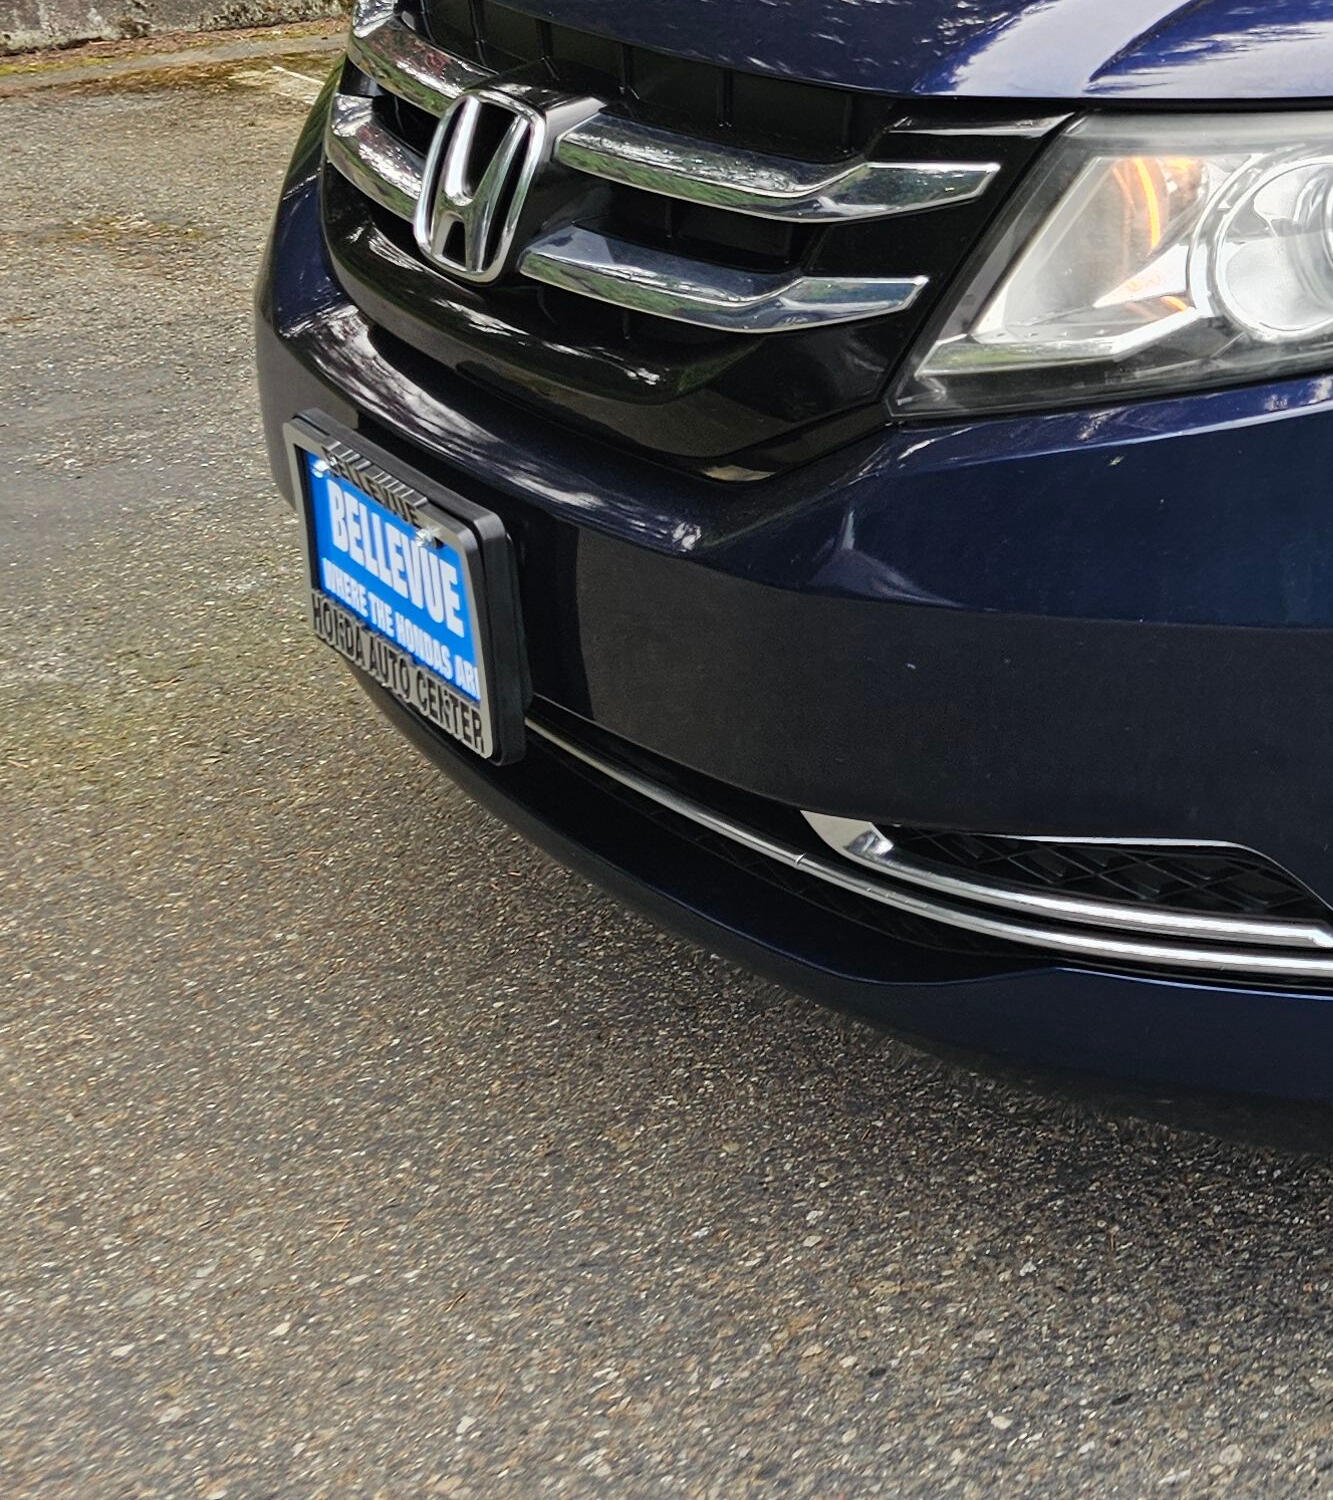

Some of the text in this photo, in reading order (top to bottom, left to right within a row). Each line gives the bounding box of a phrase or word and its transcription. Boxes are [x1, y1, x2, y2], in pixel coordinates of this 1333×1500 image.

[321, 556, 369, 618] WHERE
[367, 591, 396, 638] THE
[395, 611, 454, 680] HONDAS
[326, 478, 465, 638] BELLEVUE
[311, 588, 484, 750] HONDA AUTO CENTER
